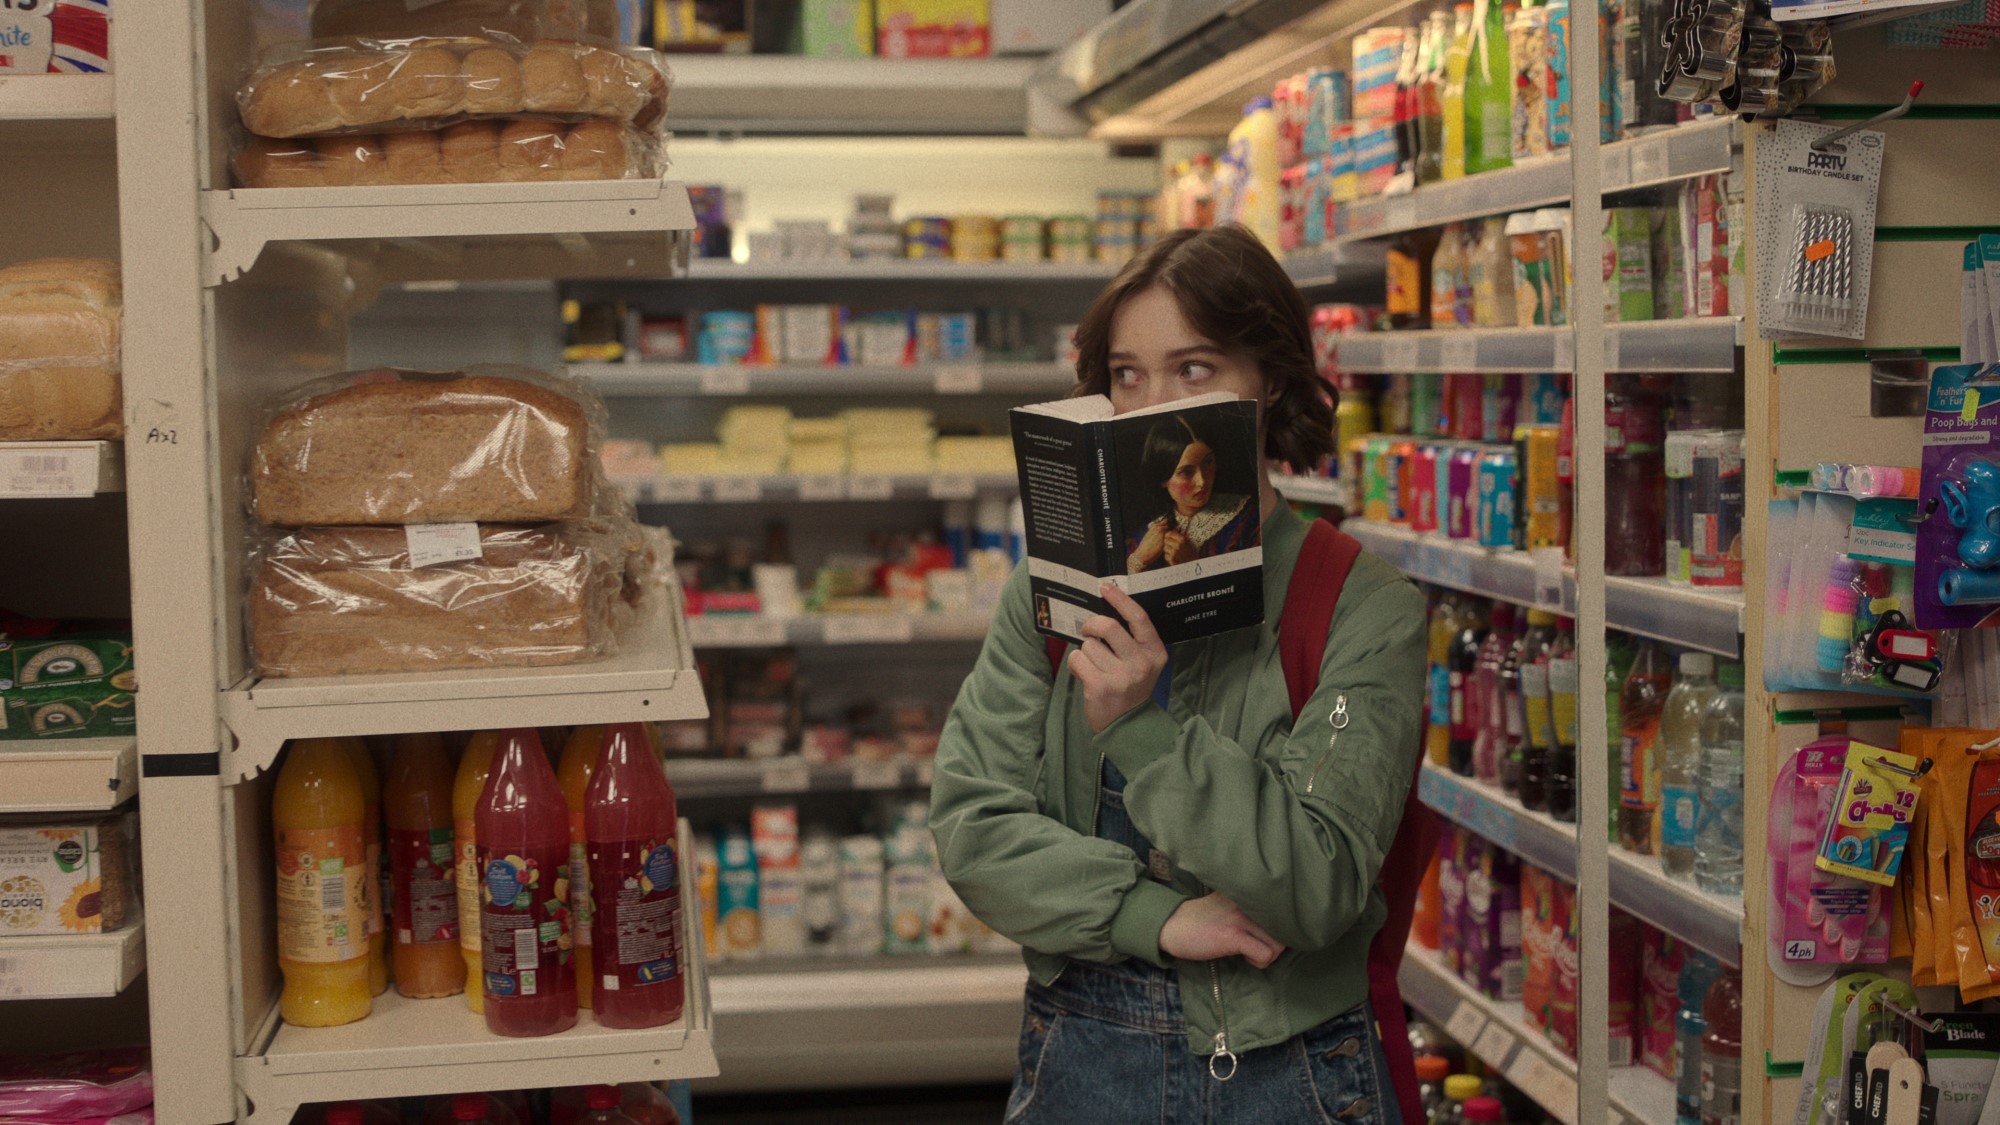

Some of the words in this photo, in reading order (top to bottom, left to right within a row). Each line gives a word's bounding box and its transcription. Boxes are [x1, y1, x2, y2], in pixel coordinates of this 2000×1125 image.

[1807, 152, 1847, 171] PARTY
[1787, 166, 1822, 177] BIRTHDAY
[1822, 170, 1851, 180] CANDLE
[1937, 386, 1967, 396] Feathers
[1931, 417, 1955, 430] Poop
[1957, 416, 1979, 429] Bags
[1981, 415, 1998, 426] and
[1097, 448, 1106, 484] CHARLOTTE
[1104, 517, 1112, 533] JANE
[1106, 533, 1114, 549] EYRE
[1855, 537, 1868, 545] Key
[1870, 539, 1904, 549] Indicator
[1166, 592, 1205, 608] CHARLOTTE
[1184, 613, 1200, 623] JANE
[1202, 610, 1218, 619] EYRE
[1896, 790, 1915, 808] 12
[1848, 800, 1908, 823] Chalks
[1, 897, 43, 911] biona
[1947, 1029, 1986, 1040] Blade
[1941, 1081, 1948, 1089] 5
[1795, 1081, 1815, 1125] CREW
[1943, 1090, 1980, 1102] Spra
